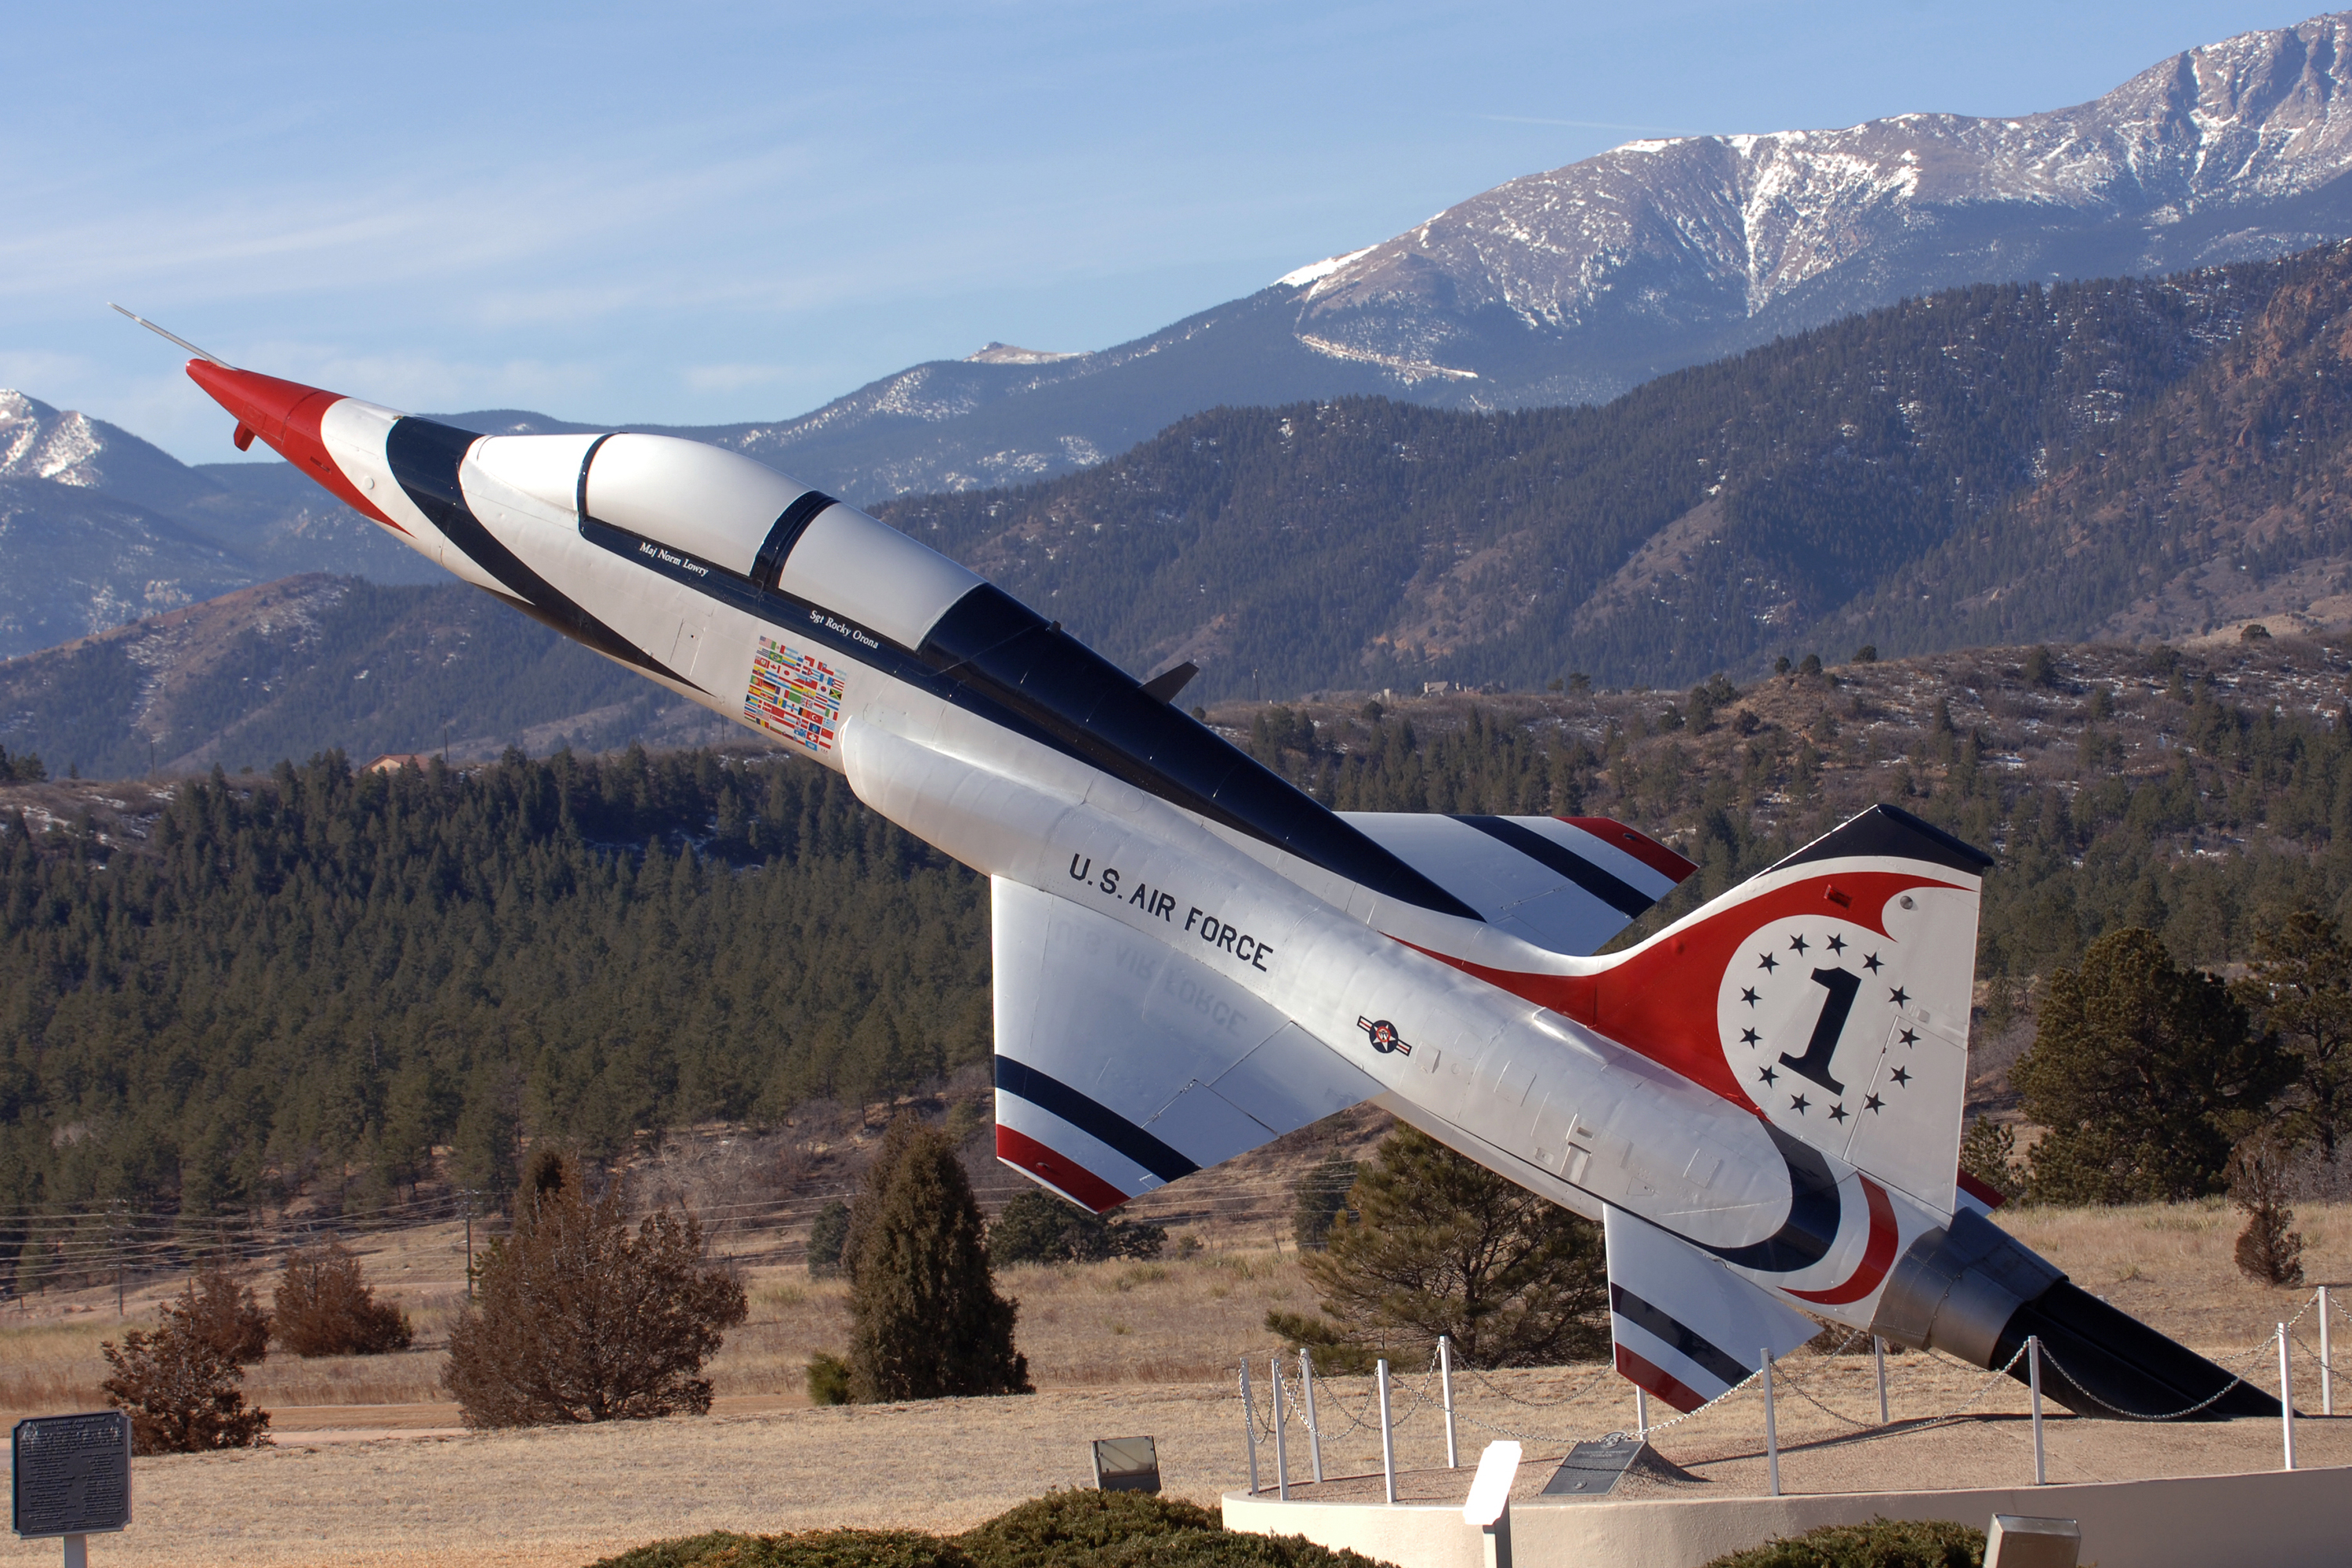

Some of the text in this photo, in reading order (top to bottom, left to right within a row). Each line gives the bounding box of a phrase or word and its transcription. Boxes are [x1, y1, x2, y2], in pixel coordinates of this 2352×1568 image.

[639, 542, 709, 577] Maj Norm Lowry
[809, 610, 879, 649] Sgt Rocky Orona
[1128, 882, 1176, 923] AIR
[1184, 906, 1274, 973] FORCE
[1778, 966, 1862, 1097] 1
